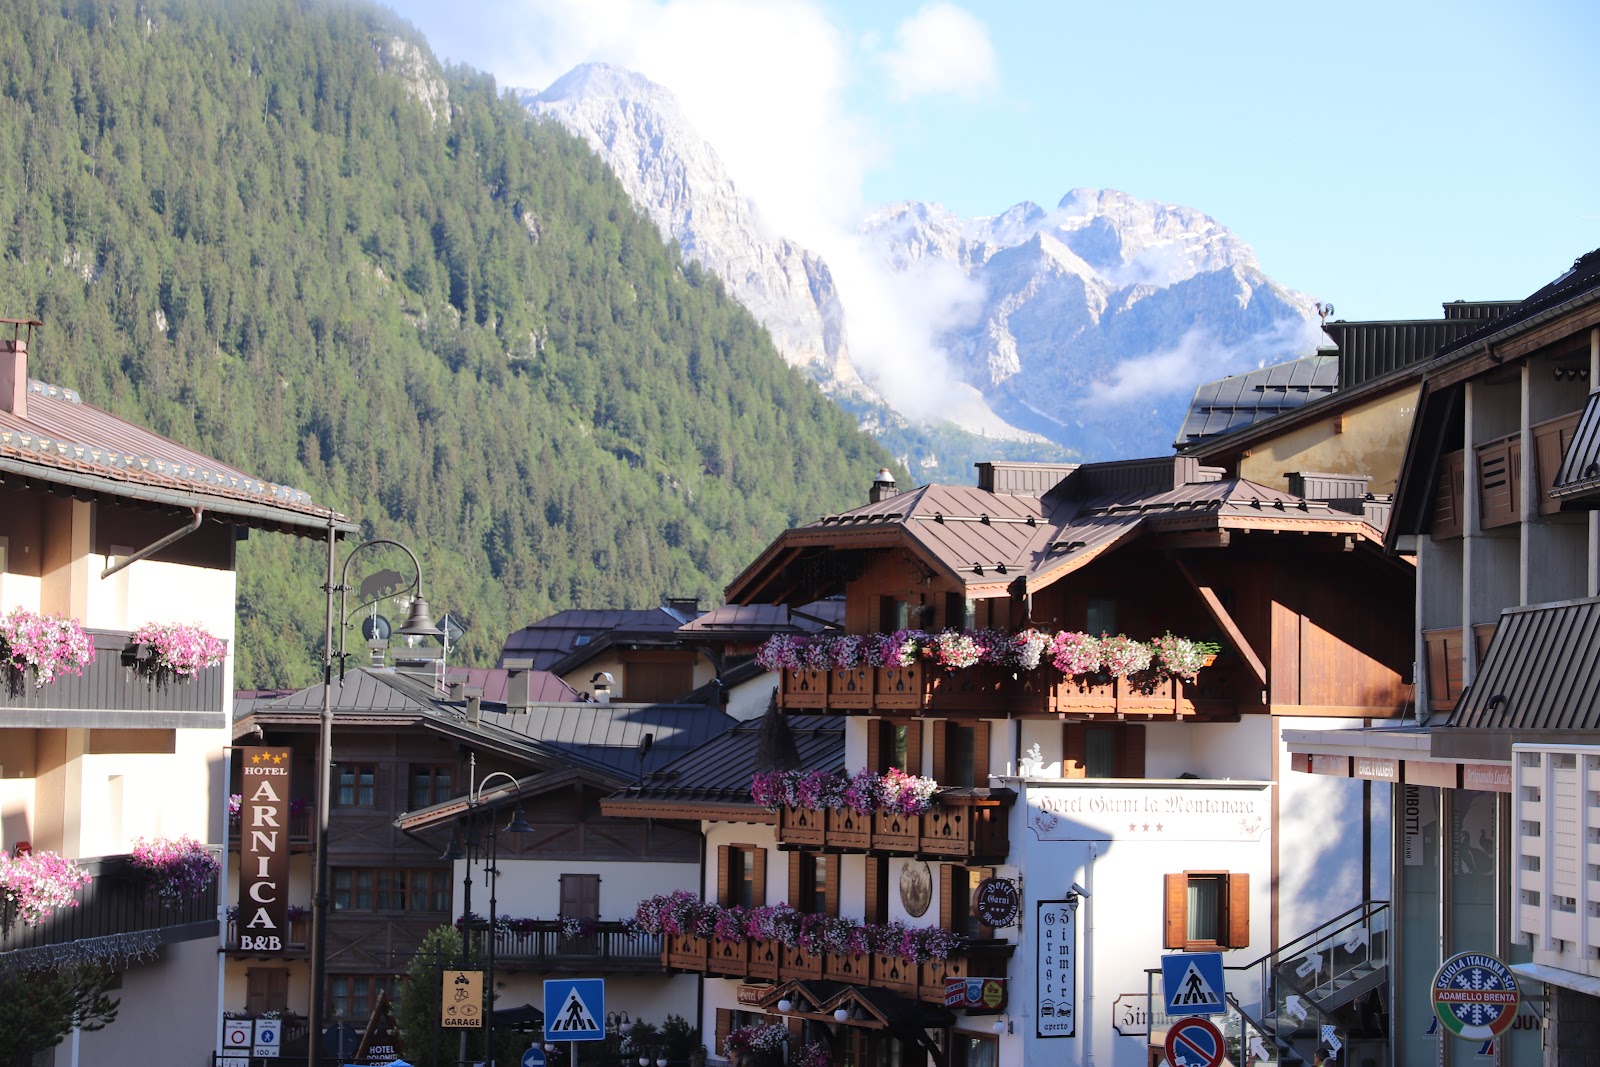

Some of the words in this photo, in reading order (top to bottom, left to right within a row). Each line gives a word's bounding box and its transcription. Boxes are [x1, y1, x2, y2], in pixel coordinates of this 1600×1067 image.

[244, 767, 288, 775] HOTEL
[1038, 796, 1082, 813] Hotel
[1089, 796, 1138, 813] Garni
[1144, 796, 1159, 813] la
[1166, 796, 1254, 813] Montanara
[1406, 785, 1419, 835] MBOTTI
[246, 780, 280, 929] ARNICA
[988, 882, 1014, 894] Hotel
[987, 895, 1009, 904] Garni
[240, 935, 282, 951] B&B
[1044, 913, 1055, 993] Garage
[1059, 908, 1069, 997] Zimmer
[1438, 959, 1465, 988] SCUOLA
[1466, 956, 1505, 977] ITALIANA
[1502, 975, 1516, 991] SCI
[1438, 992, 1482, 1000] ADAMELLO
[1483, 993, 1516, 1002] BRENTA
[1044, 1023, 1068, 1031] aperto
[369, 1046, 395, 1054] HOTEL
